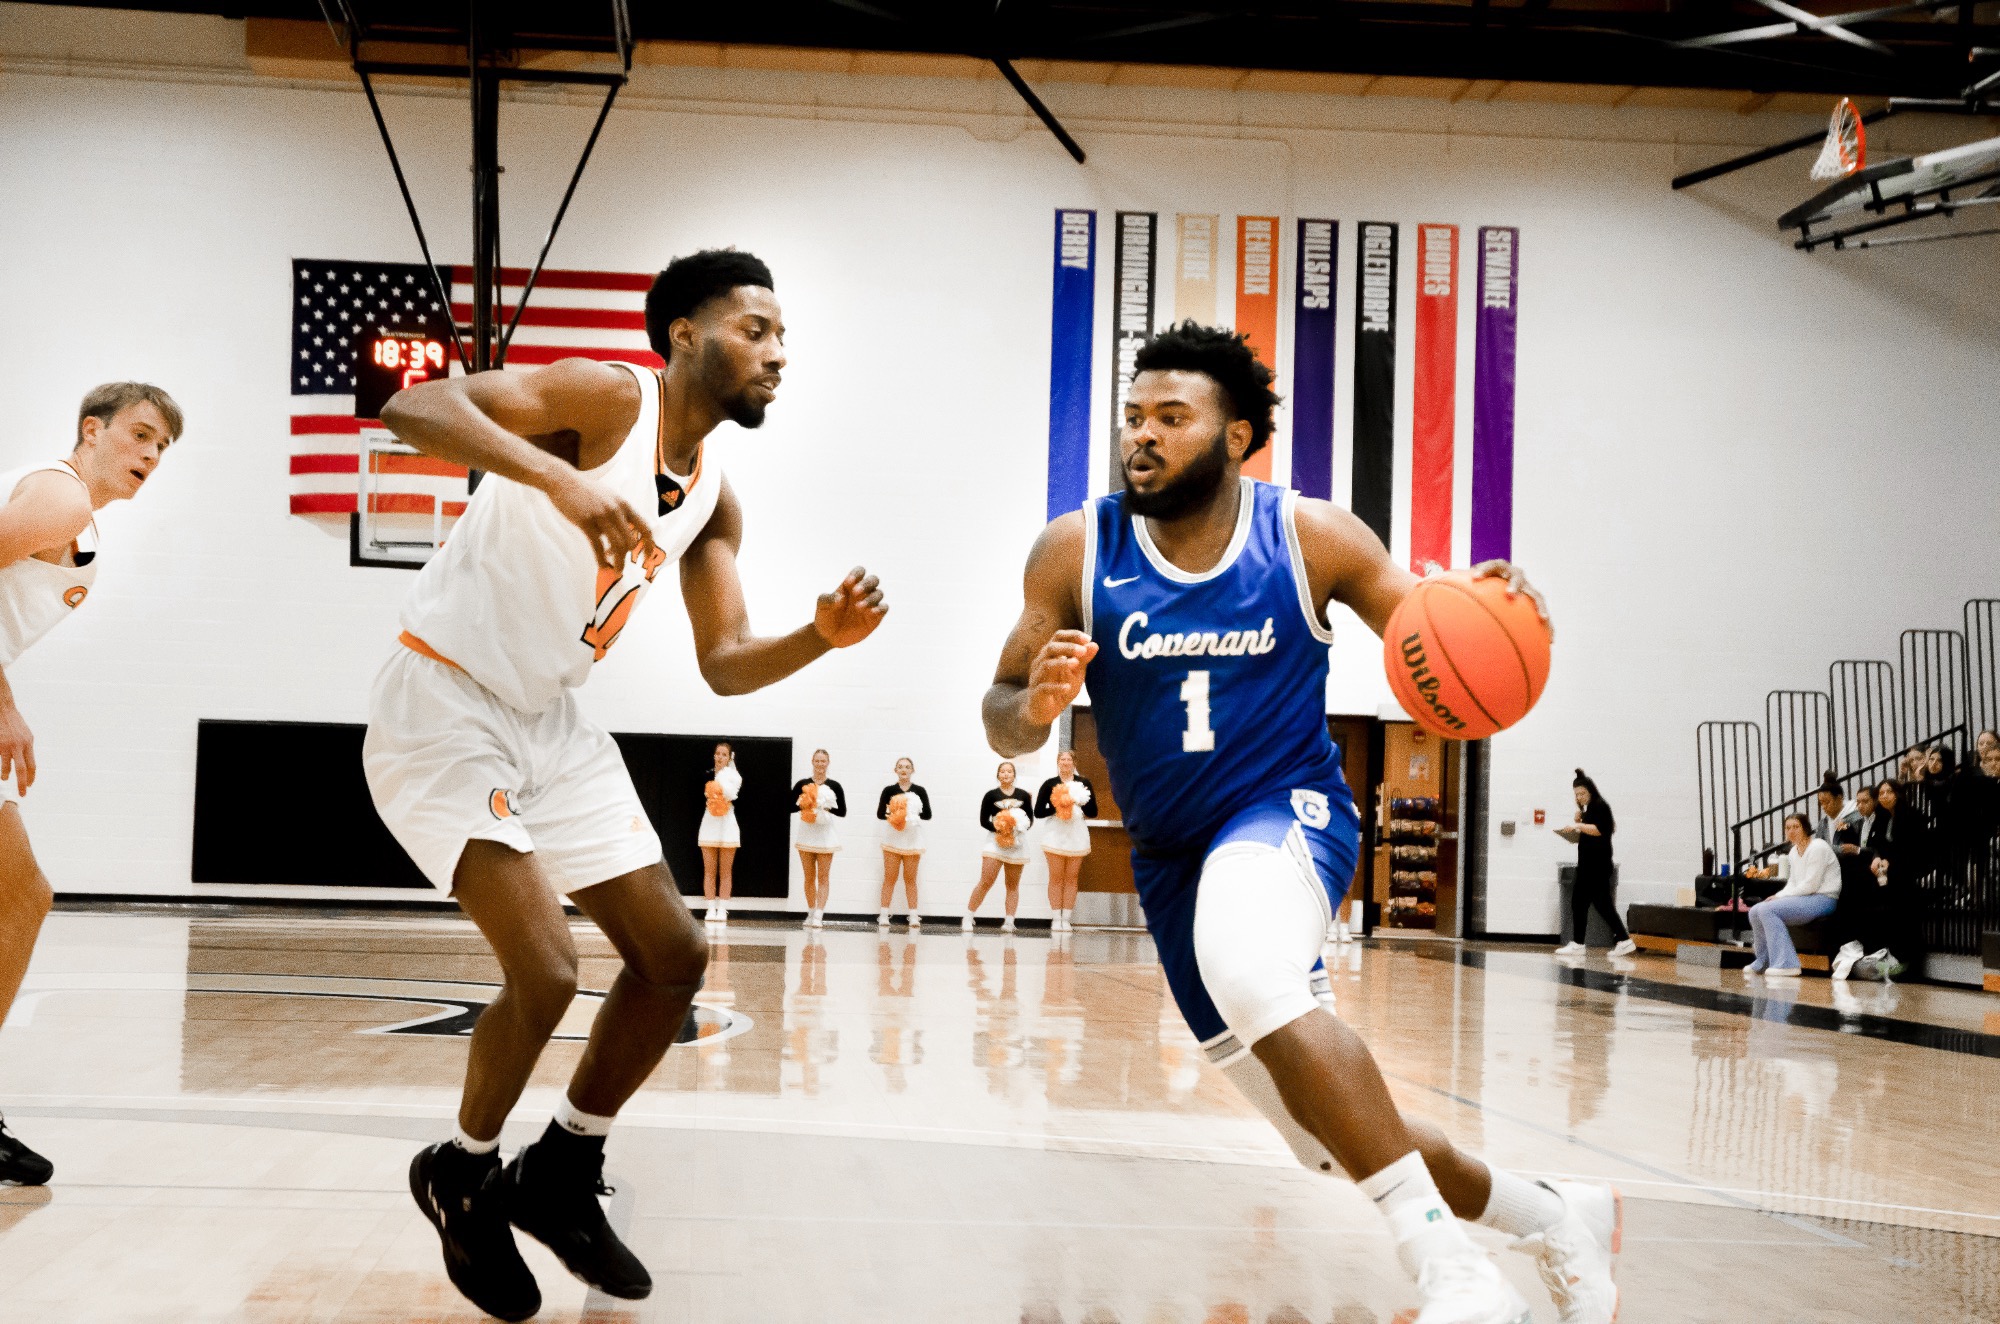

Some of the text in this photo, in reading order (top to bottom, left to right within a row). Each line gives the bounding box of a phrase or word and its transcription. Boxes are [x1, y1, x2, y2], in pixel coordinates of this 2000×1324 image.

[1061, 213, 1089, 269] BERRY
[1183, 218, 1210, 280] CENTRE
[1244, 220, 1271, 295] HENDRIX
[1303, 222, 1331, 308] MILLSAPS
[1363, 225, 1391, 331] OGLETHORPE
[1424, 228, 1451, 295] RHODES
[1484, 230, 1511, 308] SEWANEE
[374, 339, 444, 369] 18:39
[1118, 611, 1276, 660] Covenant
[1180, 670, 1215, 752] 1
[1401, 631, 1467, 730] Wilson
